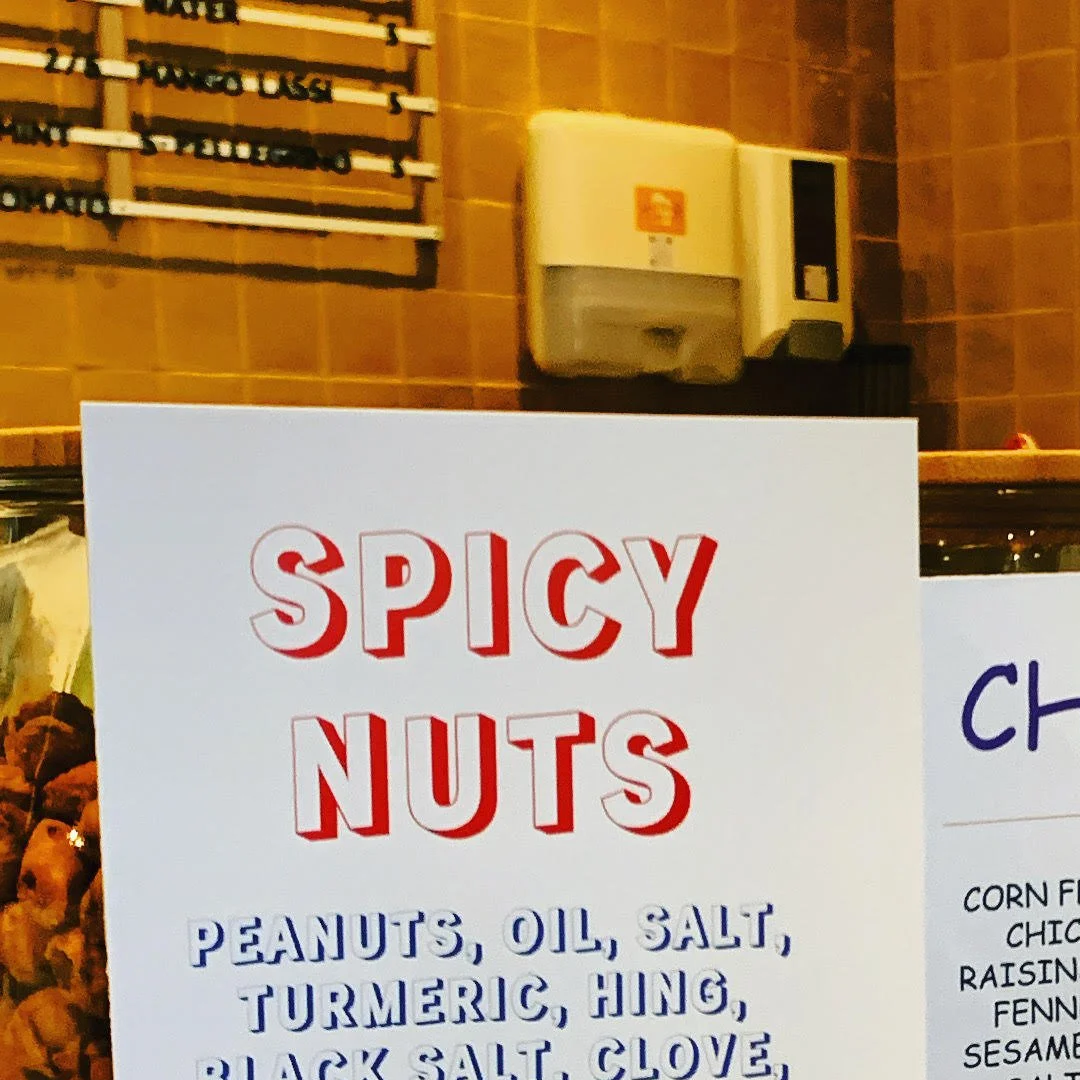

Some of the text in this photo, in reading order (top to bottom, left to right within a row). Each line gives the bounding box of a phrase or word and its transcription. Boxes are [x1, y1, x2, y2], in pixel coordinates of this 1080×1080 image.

[138, 60, 243, 96] MANGO
[258, 72, 333, 103] LASSI
[249, 525, 719, 661] SPICY
[291, 709, 692, 842] NUTS
[964, 881, 1048, 913] CORN
[190, 902, 791, 968] PEANUTS, OIL, SALT,
[238, 968, 747, 1034] TURMERIC, HING,
